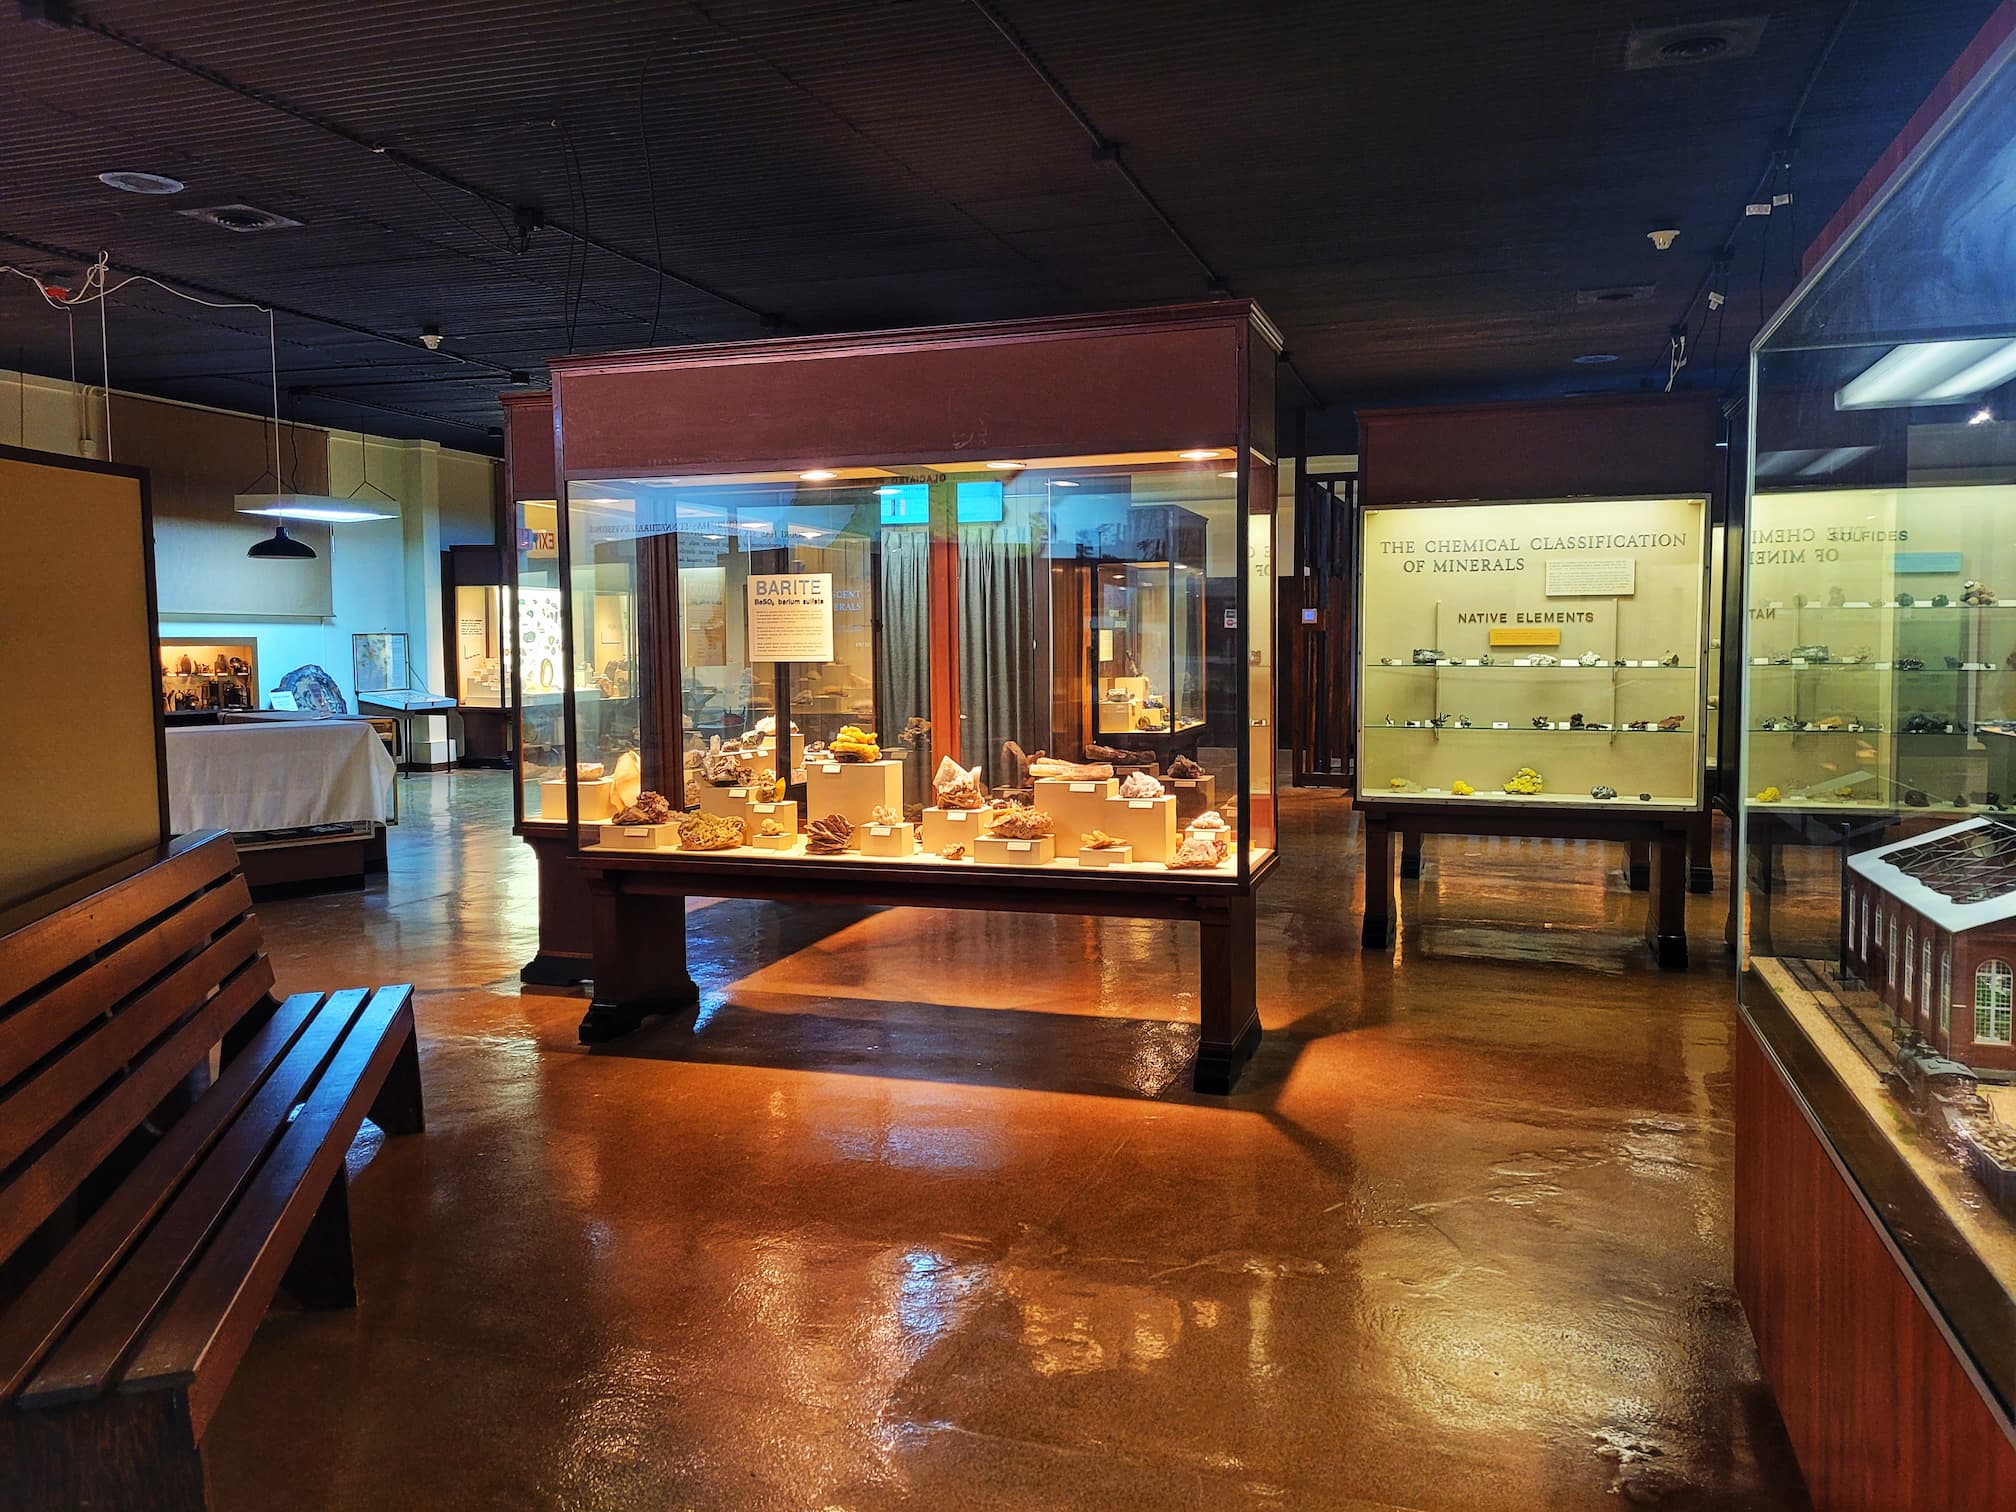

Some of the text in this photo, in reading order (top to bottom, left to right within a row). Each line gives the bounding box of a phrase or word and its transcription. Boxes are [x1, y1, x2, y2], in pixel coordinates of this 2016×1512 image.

[1381, 533, 1687, 554] THE CHEMICAL CLASSIFICATION
[1403, 558, 1525, 573] OF MINERALS
[756, 579, 821, 595] BARITE
[1458, 612, 1594, 624] NATIVE ELEMENTS
